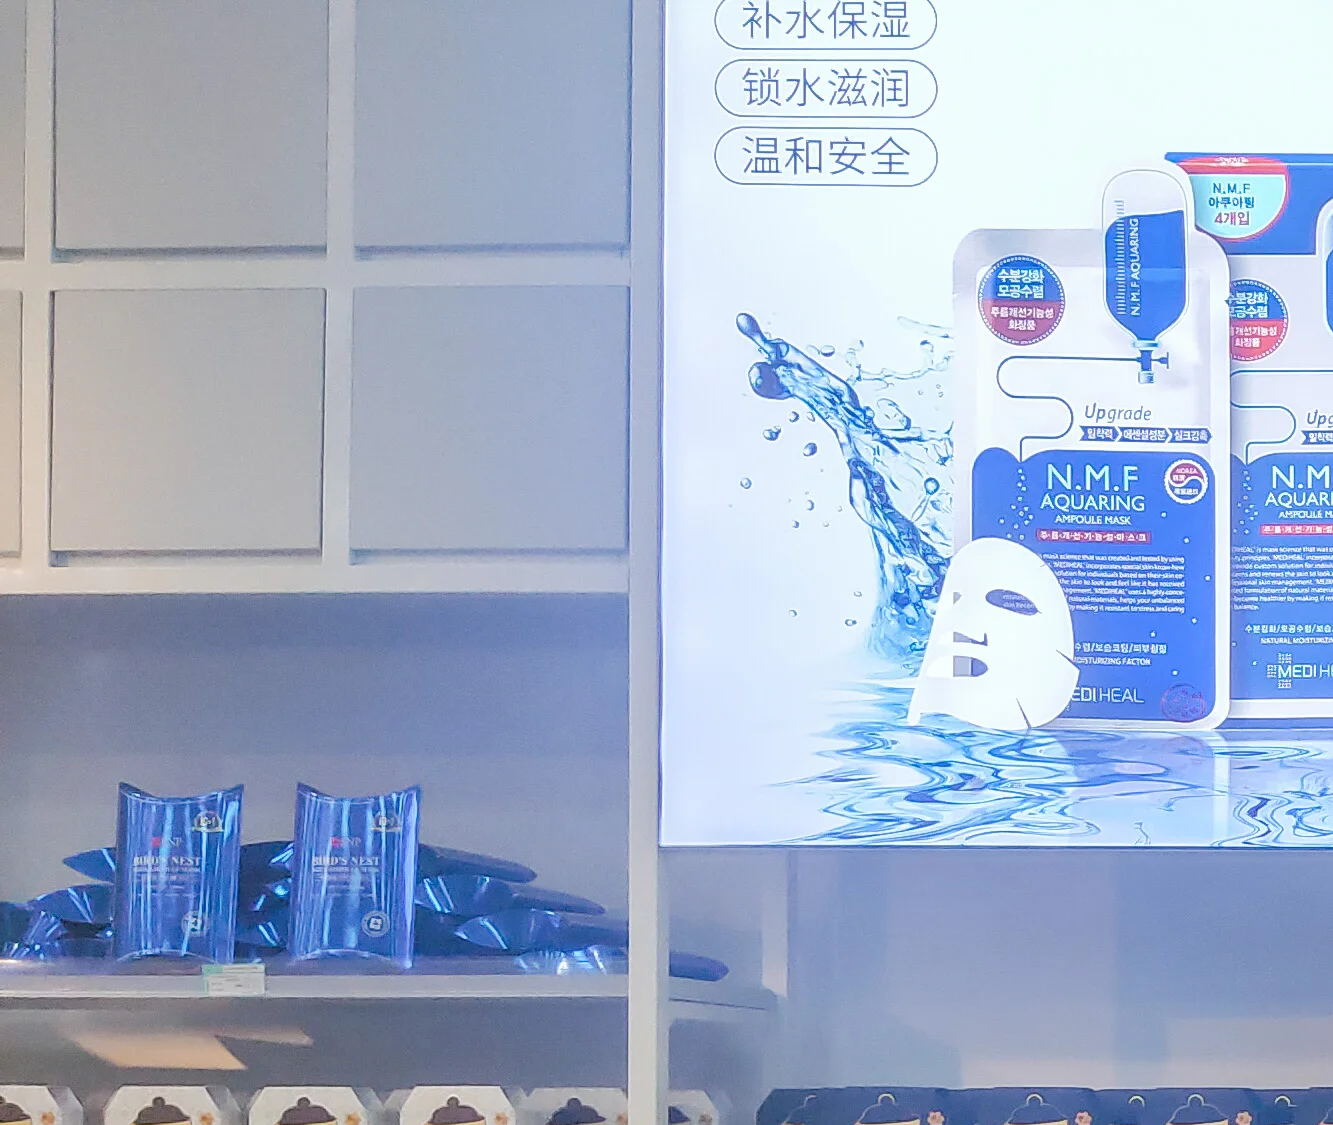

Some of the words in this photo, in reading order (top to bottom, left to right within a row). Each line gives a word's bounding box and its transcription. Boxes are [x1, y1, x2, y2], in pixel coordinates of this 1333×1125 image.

[742, 0, 911, 39] 补水保湿
[742, 67, 911, 107] 锁水滋润
[742, 136, 911, 175] 温和安全
[1212, 183, 1251, 194] N.M.F
[1214, 211, 1250, 226] 4개입
[1129, 218, 1142, 281] AQUARING
[997, 269, 1044, 284] 수분강화
[1085, 403, 1152, 423] Upgrade
[1047, 463, 1139, 492] N.M.F
[1040, 493, 1145, 512] AQUARING
[1054, 514, 1102, 524] AMPOULE
[1104, 514, 1131, 525] MASK
[1278, 509, 1322, 519] AMPOULE
[1072, 687, 1145, 703] EDIHEAL
